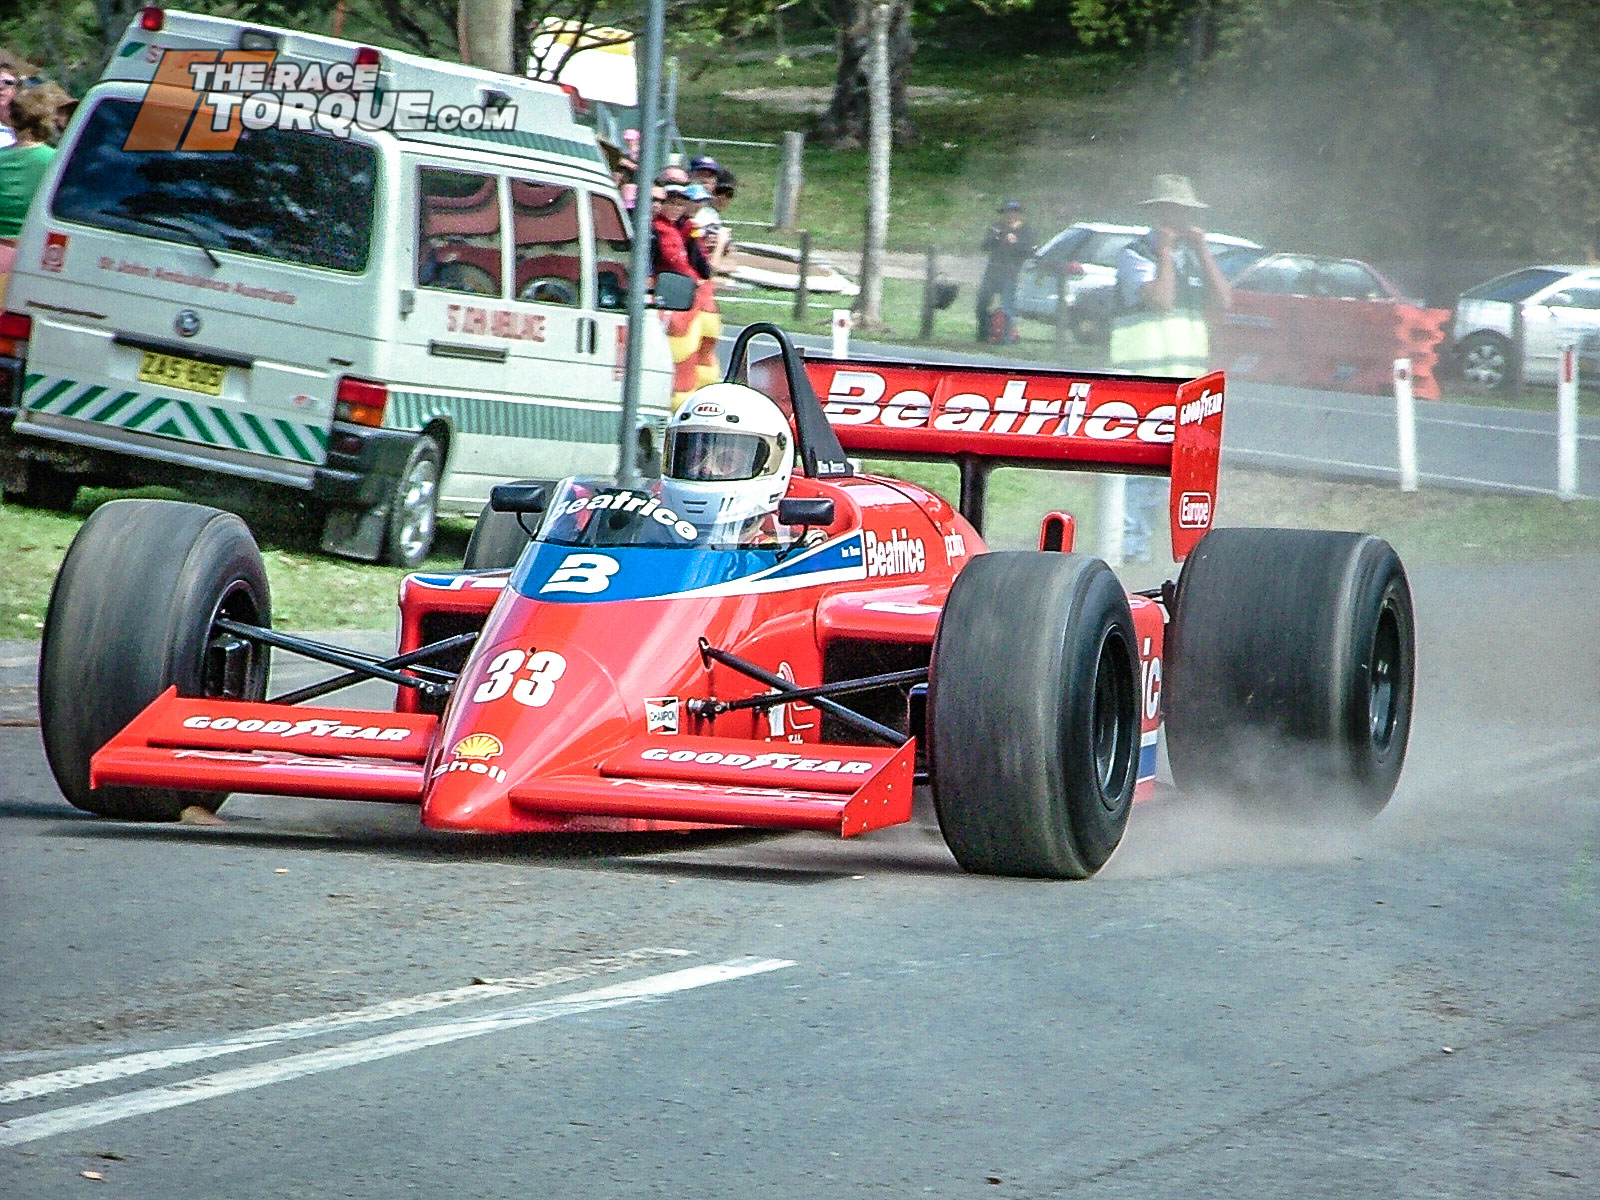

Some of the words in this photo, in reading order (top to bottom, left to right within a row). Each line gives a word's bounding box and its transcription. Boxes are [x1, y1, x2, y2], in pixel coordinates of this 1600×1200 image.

[697, 405, 720, 413] BELL
[824, 370, 1177, 443] Beatrice
[1181, 496, 1209, 525] Europe
[865, 528, 926, 576] Beatrice
[473, 649, 567, 707] 33
